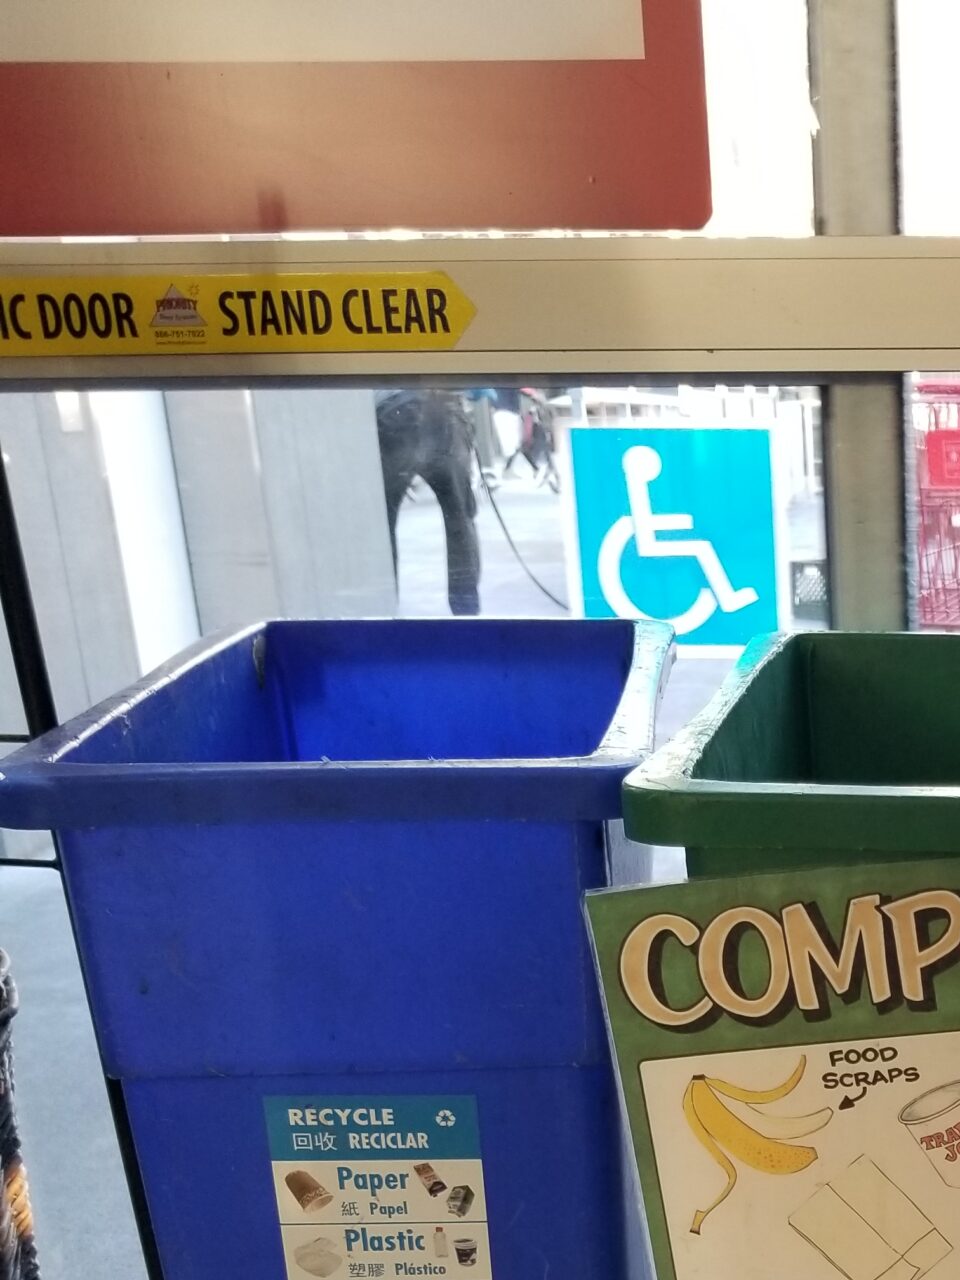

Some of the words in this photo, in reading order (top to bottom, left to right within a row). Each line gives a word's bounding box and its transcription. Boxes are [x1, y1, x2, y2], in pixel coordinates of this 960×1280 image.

[37, 292, 139, 340] DOOR
[218, 289, 331, 337] STAND
[342, 288, 452, 335] CLEAR
[828, 1046, 899, 1067] FOOD
[821, 1066, 921, 1089] SCRAPS
[287, 1108, 395, 1126] RECYCLE
[292, 1132, 338, 1151] 回收
[348, 1132, 430, 1149] RECICLAR
[336, 1166, 409, 1197] Paper
[340, 1201, 360, 1217] 紙
[369, 1201, 408, 1218] Papel
[344, 1227, 426, 1252] Plastic
[348, 1263, 385, 1278] 塑膠
[394, 1262, 447, 1276] Plástico
